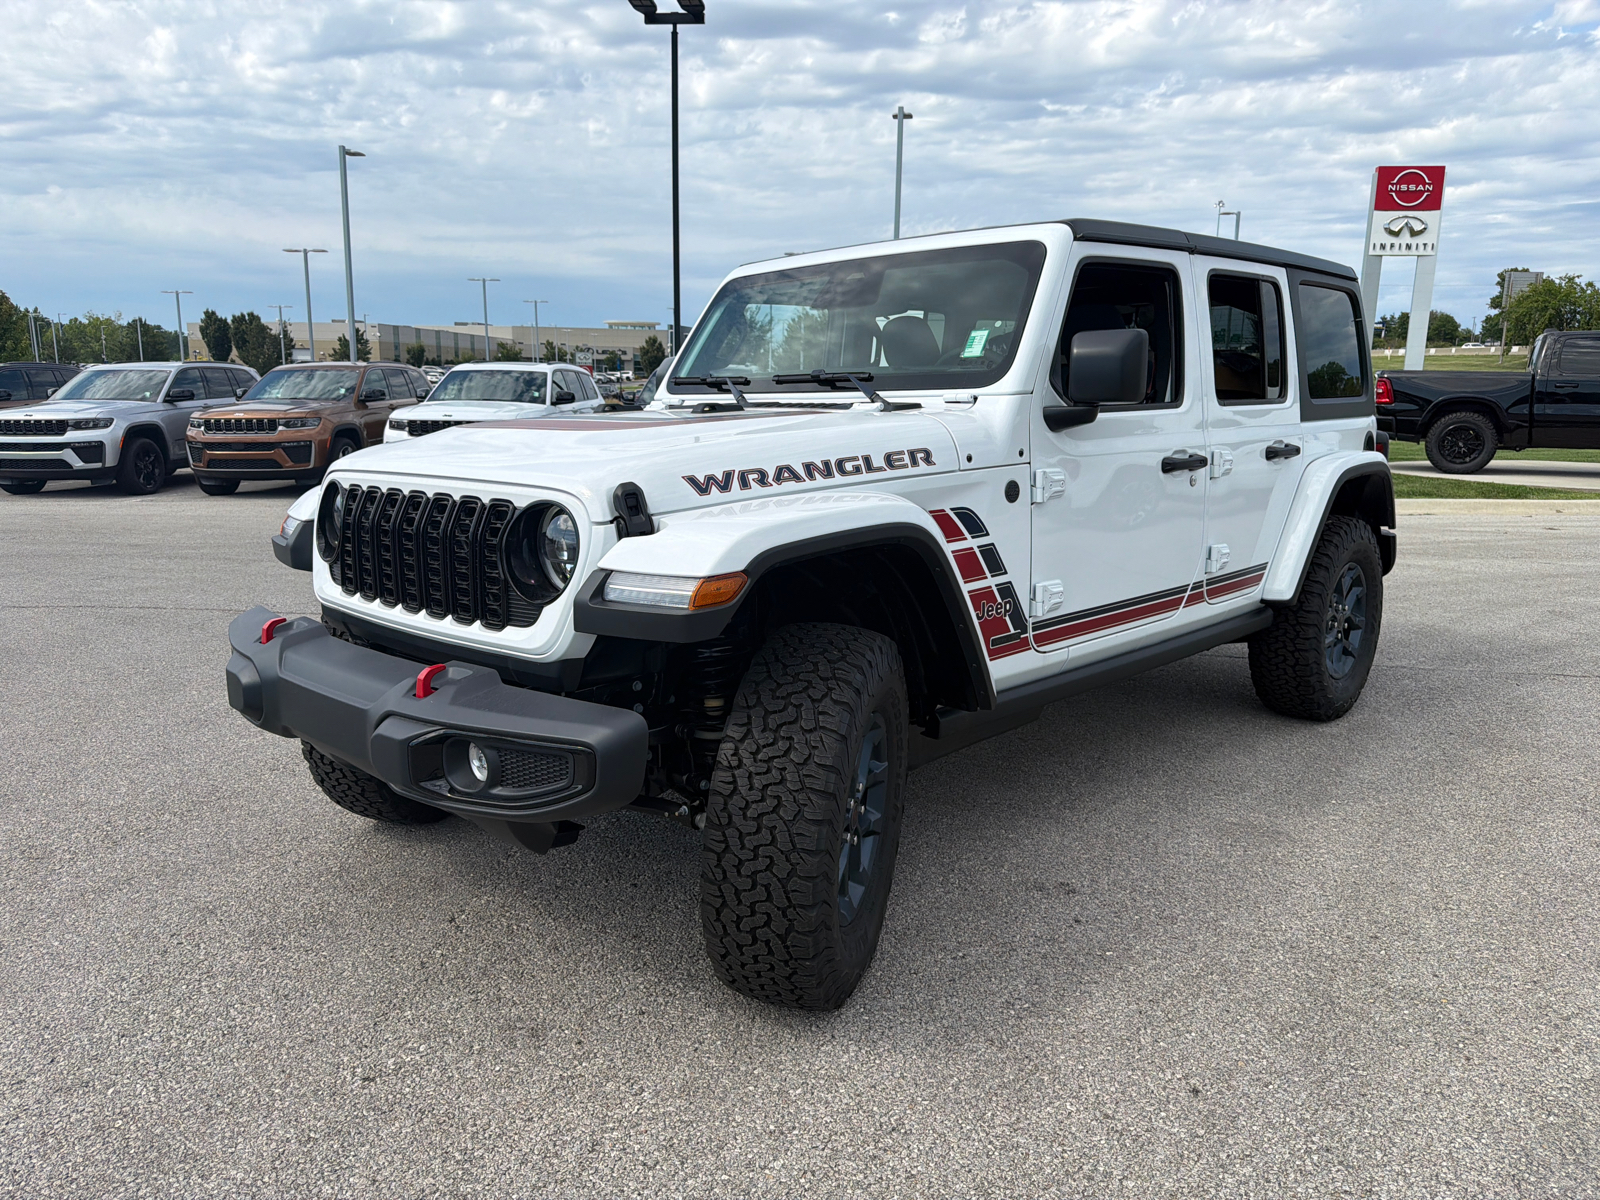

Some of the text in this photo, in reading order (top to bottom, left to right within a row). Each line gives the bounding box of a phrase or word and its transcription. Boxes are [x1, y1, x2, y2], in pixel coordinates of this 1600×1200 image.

[1372, 242, 1435, 251] INFINITI
[682, 448, 936, 496] WRANGLER
[975, 598, 1013, 622] Jeep
